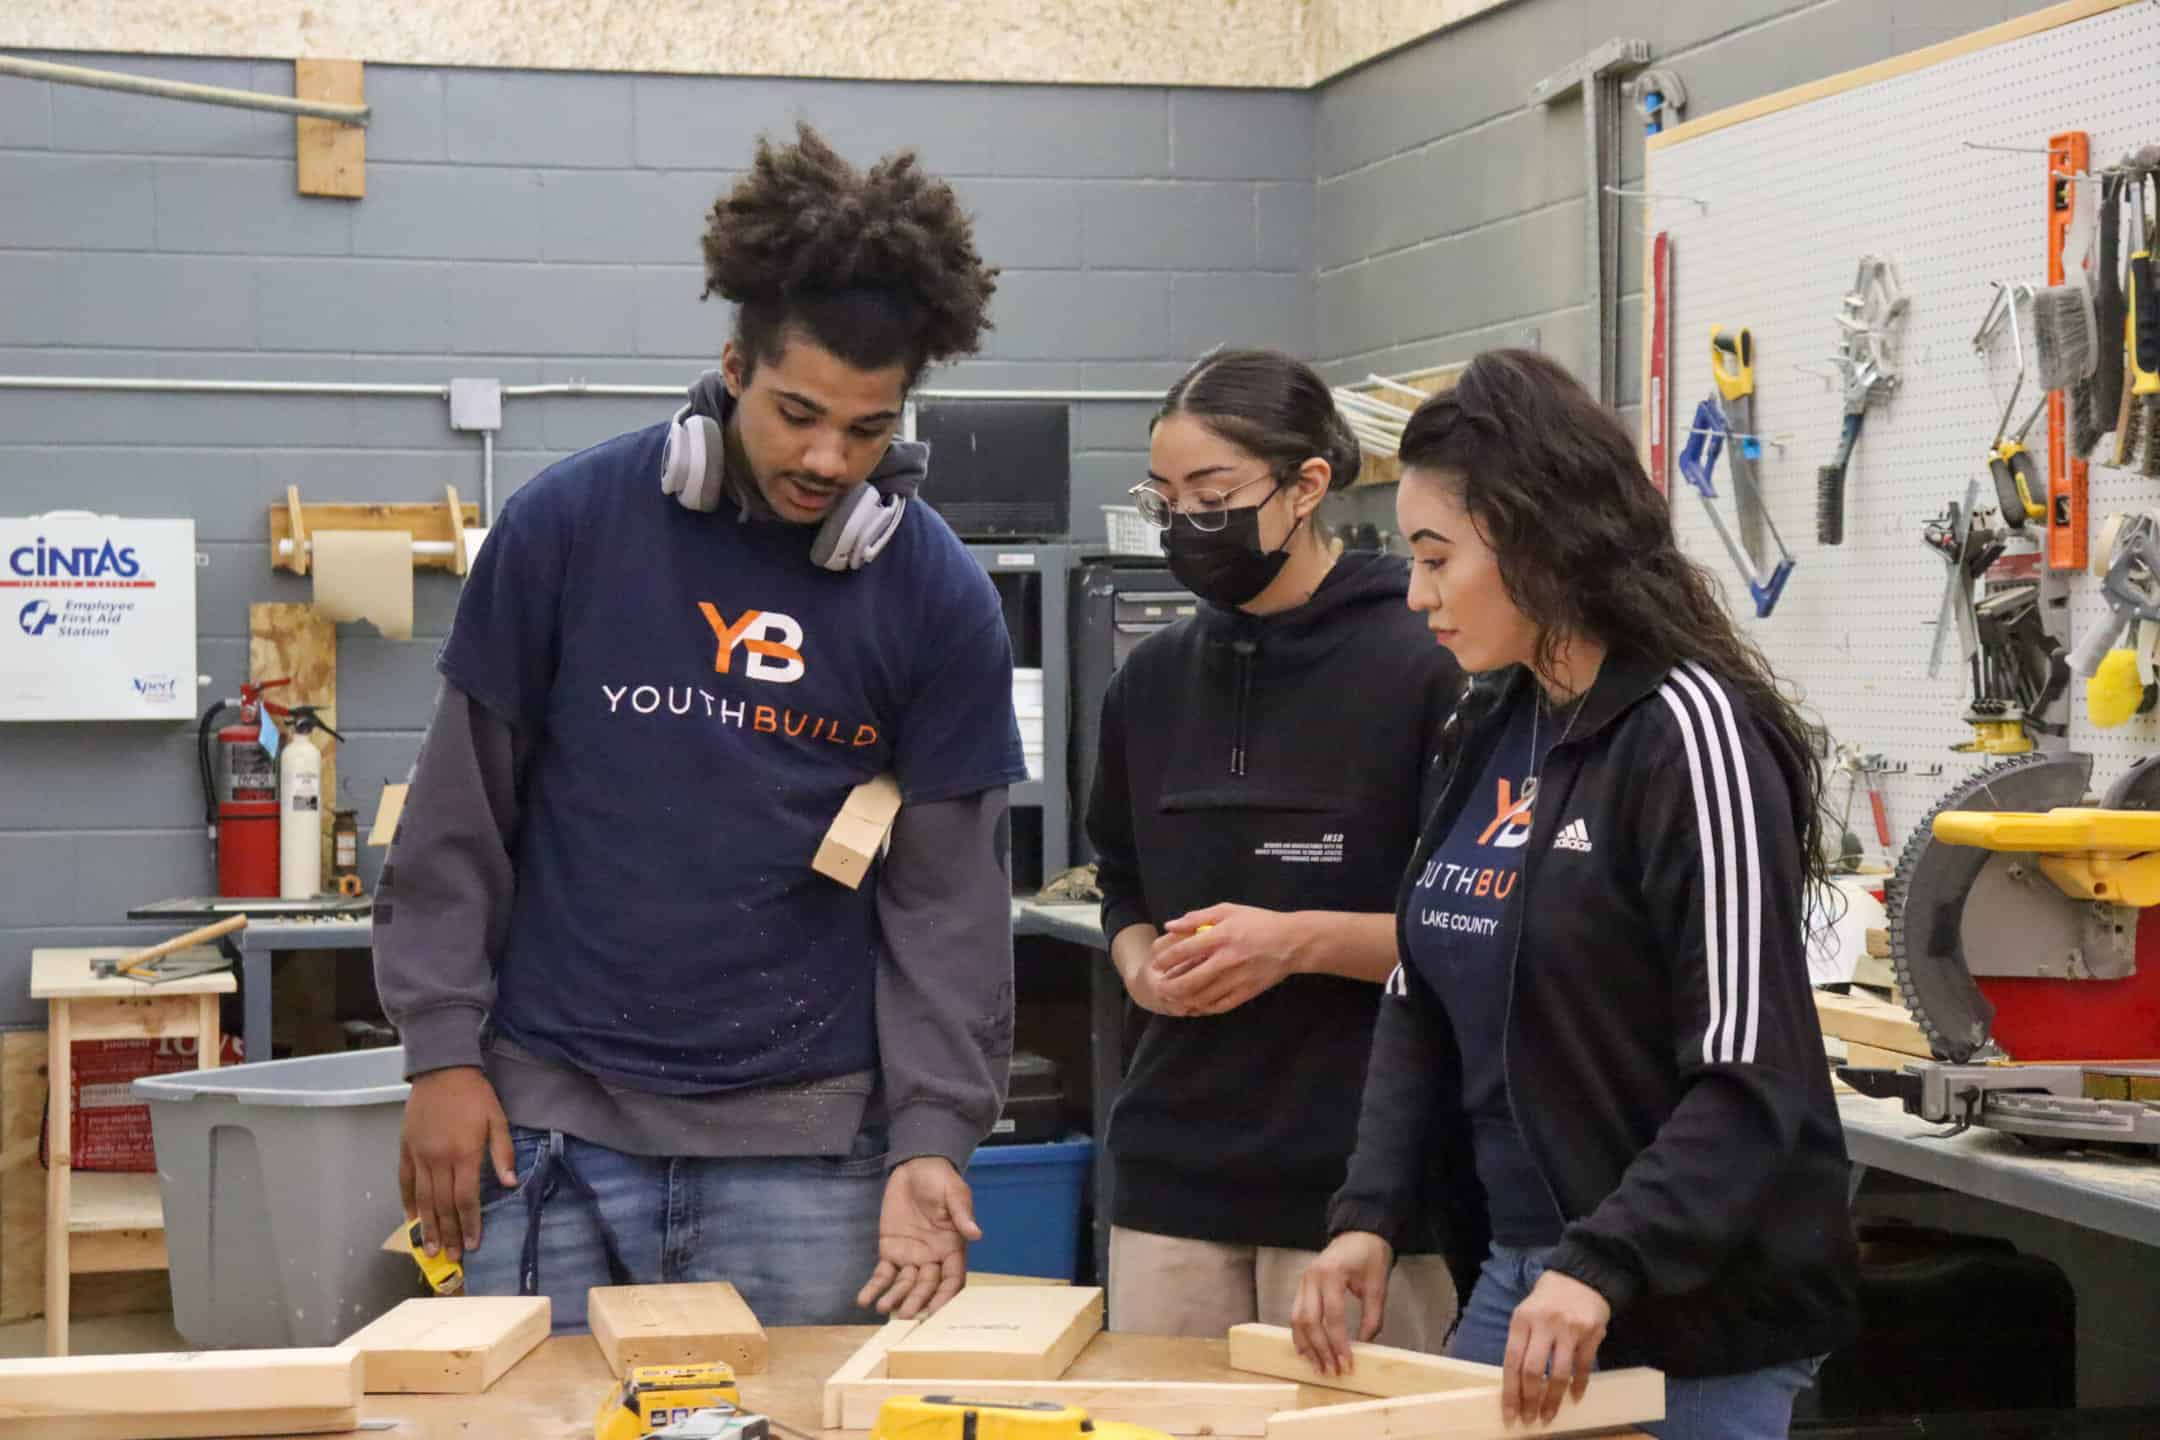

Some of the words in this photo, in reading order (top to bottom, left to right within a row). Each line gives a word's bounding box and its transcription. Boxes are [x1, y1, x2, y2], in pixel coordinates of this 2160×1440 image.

[64, 600, 135, 614] Employee
[61, 613, 92, 624] First
[97, 613, 121, 624] Aid
[57, 626, 110, 637] Station
[697, 600, 805, 683] YB
[602, 685, 878, 746] YOUTHBUILD
[1421, 909, 1449, 930] LAKE
[1451, 914, 1499, 937] COUNTY
